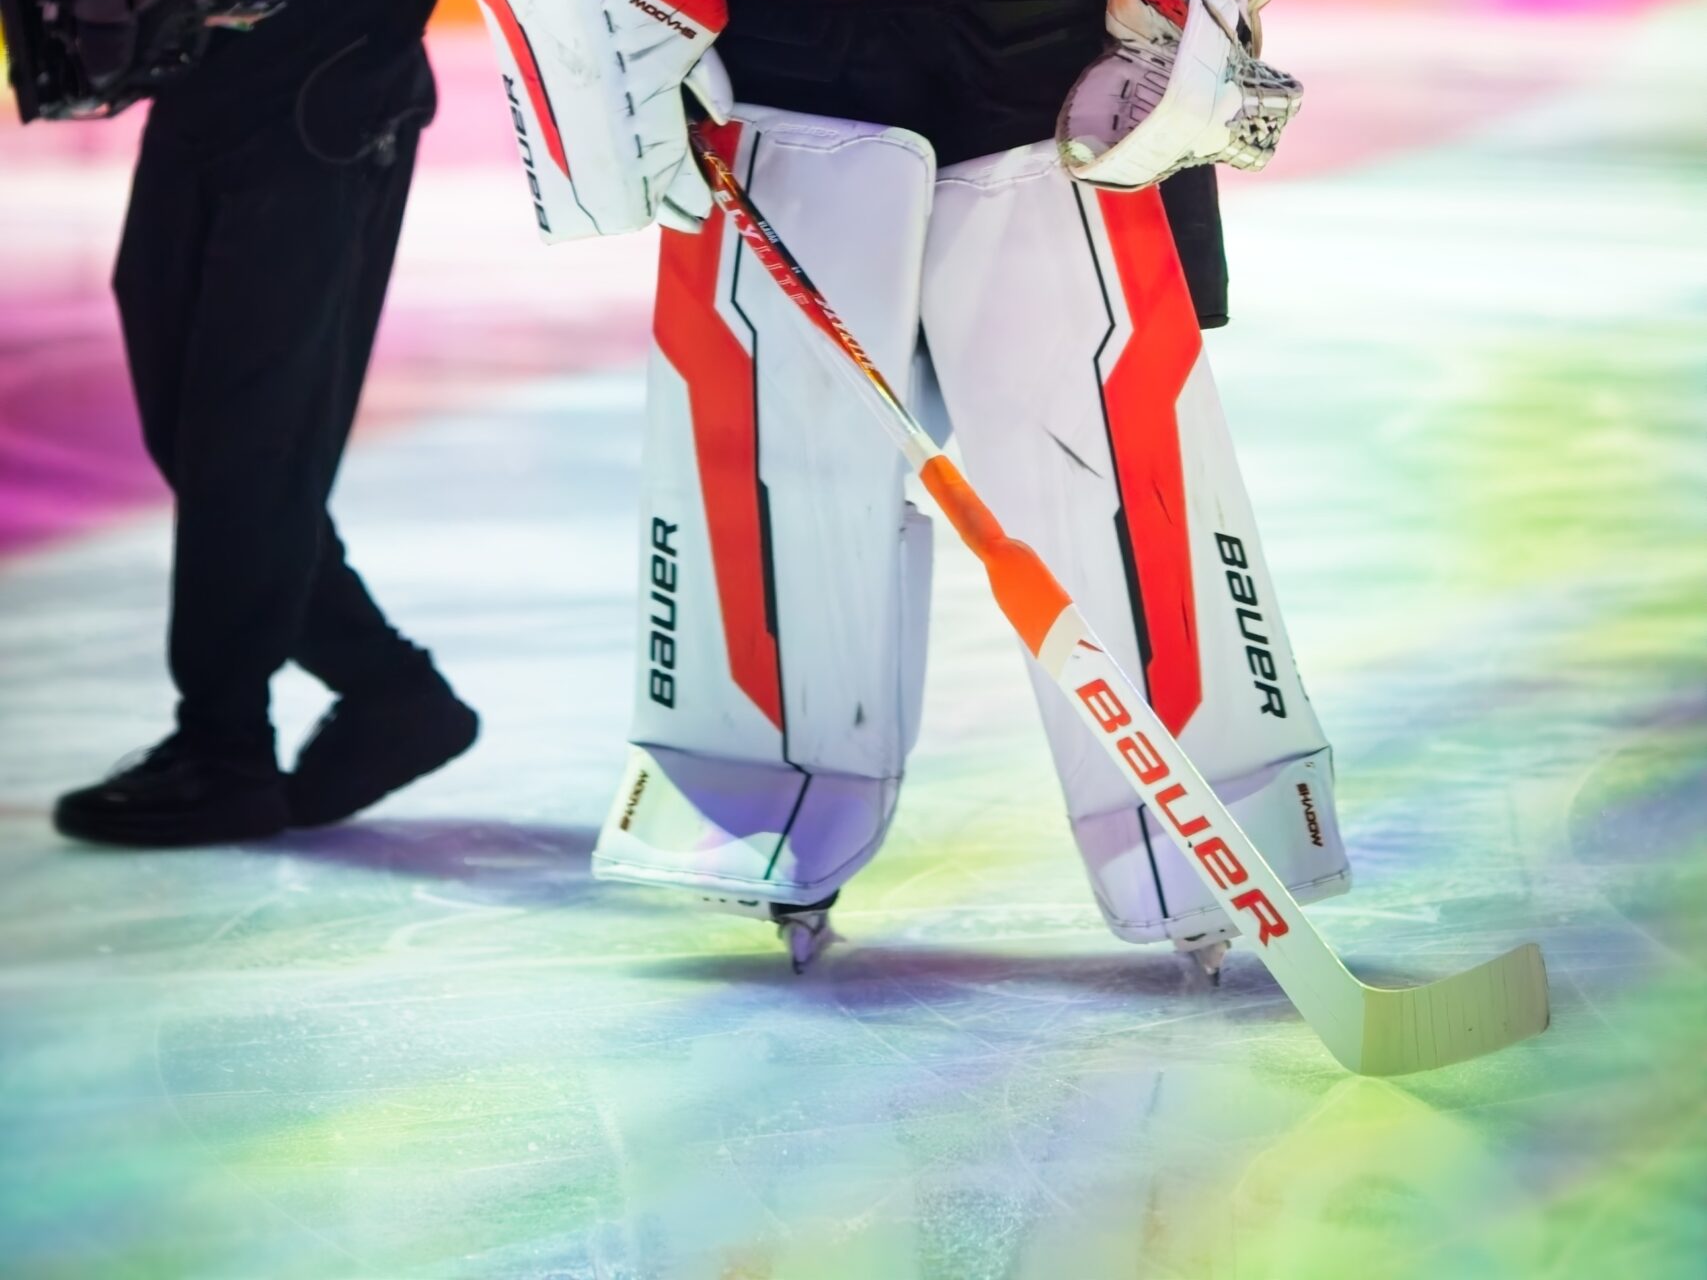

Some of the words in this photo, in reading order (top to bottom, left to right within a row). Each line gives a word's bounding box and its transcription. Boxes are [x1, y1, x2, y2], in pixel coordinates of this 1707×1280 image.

[649, 516, 678, 709] BAUER
[1214, 532, 1288, 718] BAUER
[1075, 677, 1290, 947] BAUER
